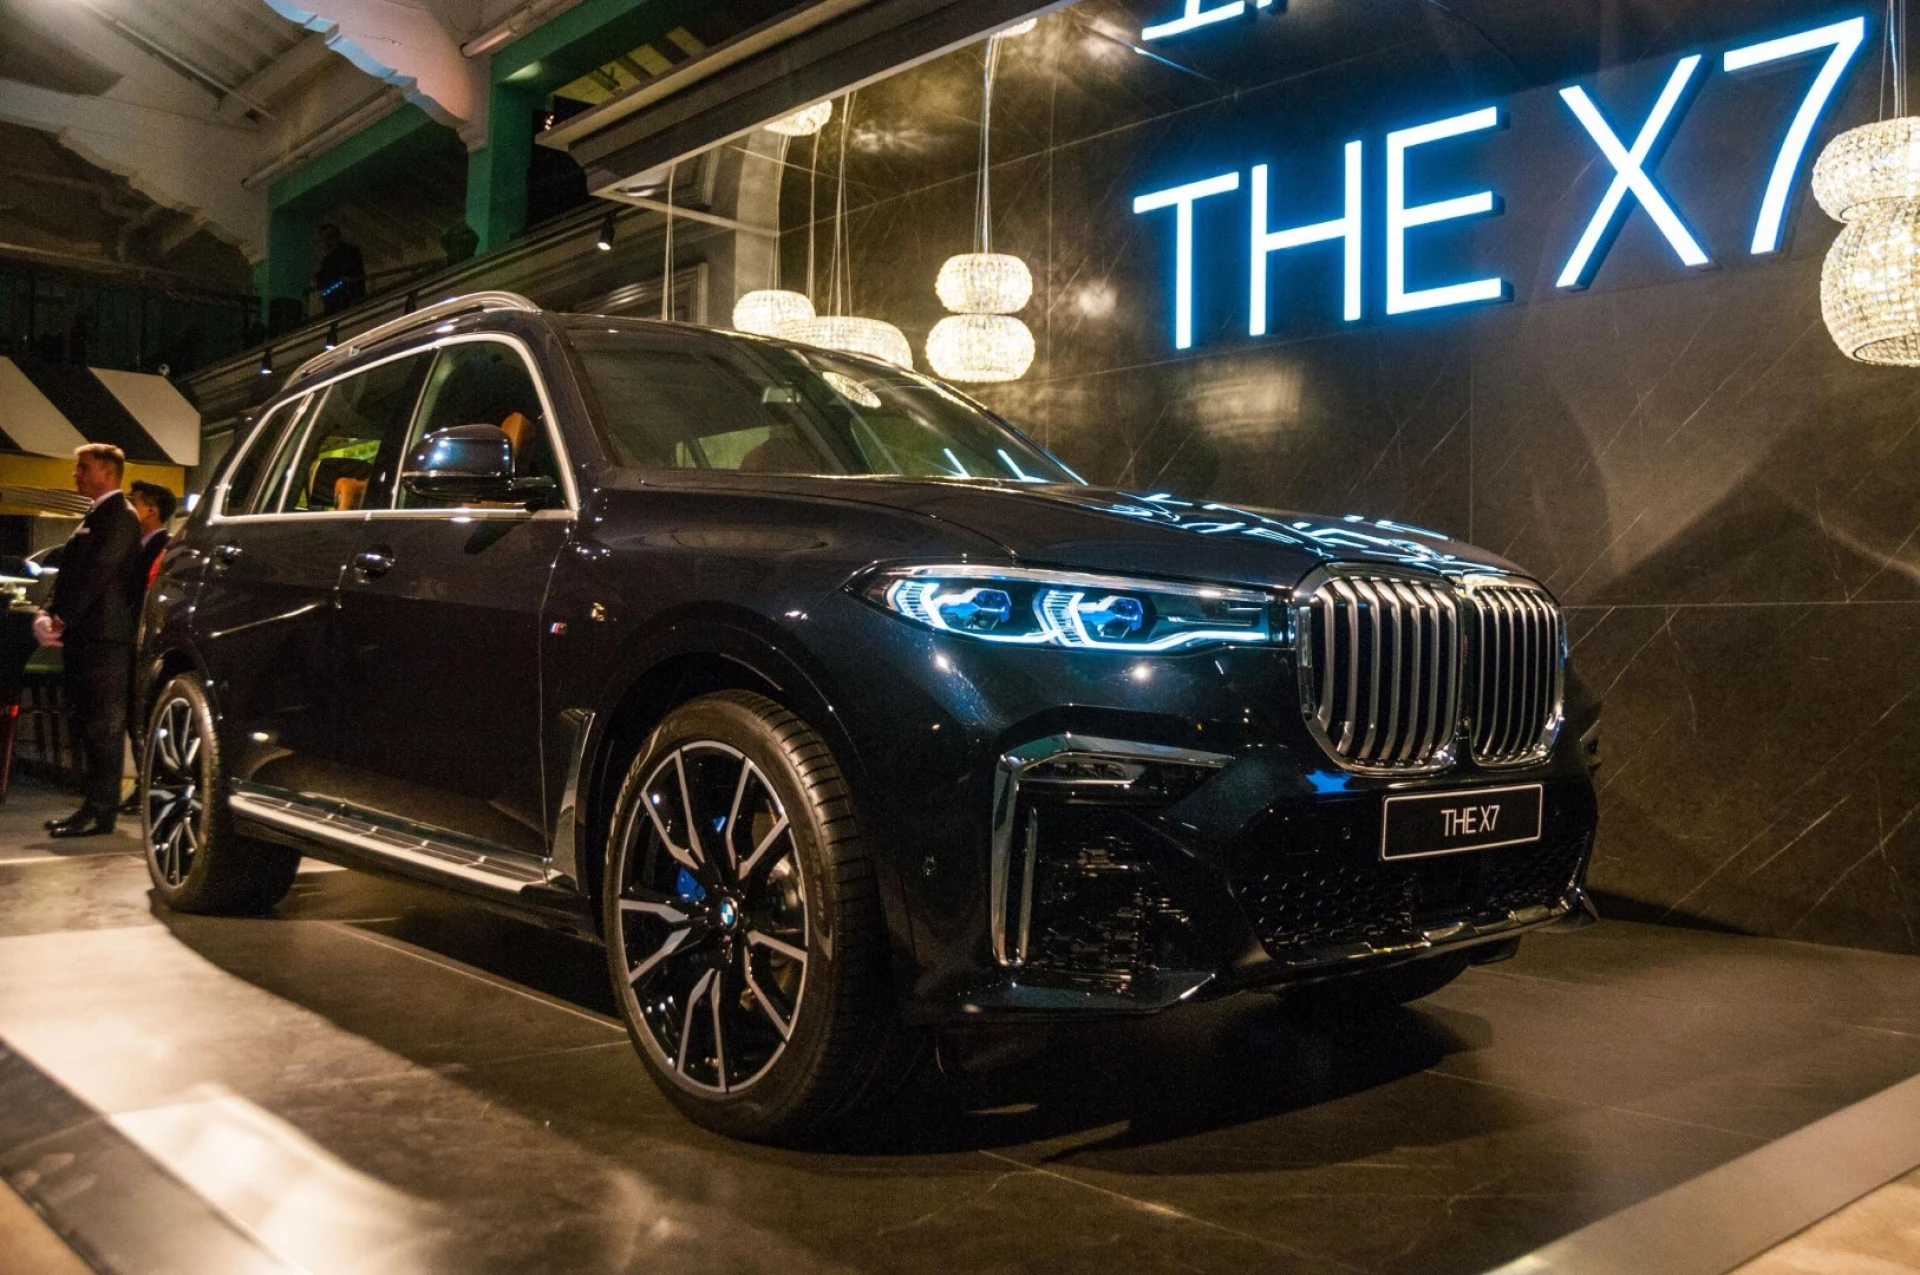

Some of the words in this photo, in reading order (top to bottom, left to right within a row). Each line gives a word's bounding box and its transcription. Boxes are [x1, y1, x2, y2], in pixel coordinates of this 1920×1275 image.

[1132, 105, 1502, 349] THE
[1555, 16, 1865, 288] X7
[1440, 806, 1478, 836] THE
[1479, 804, 1501, 832] X7
